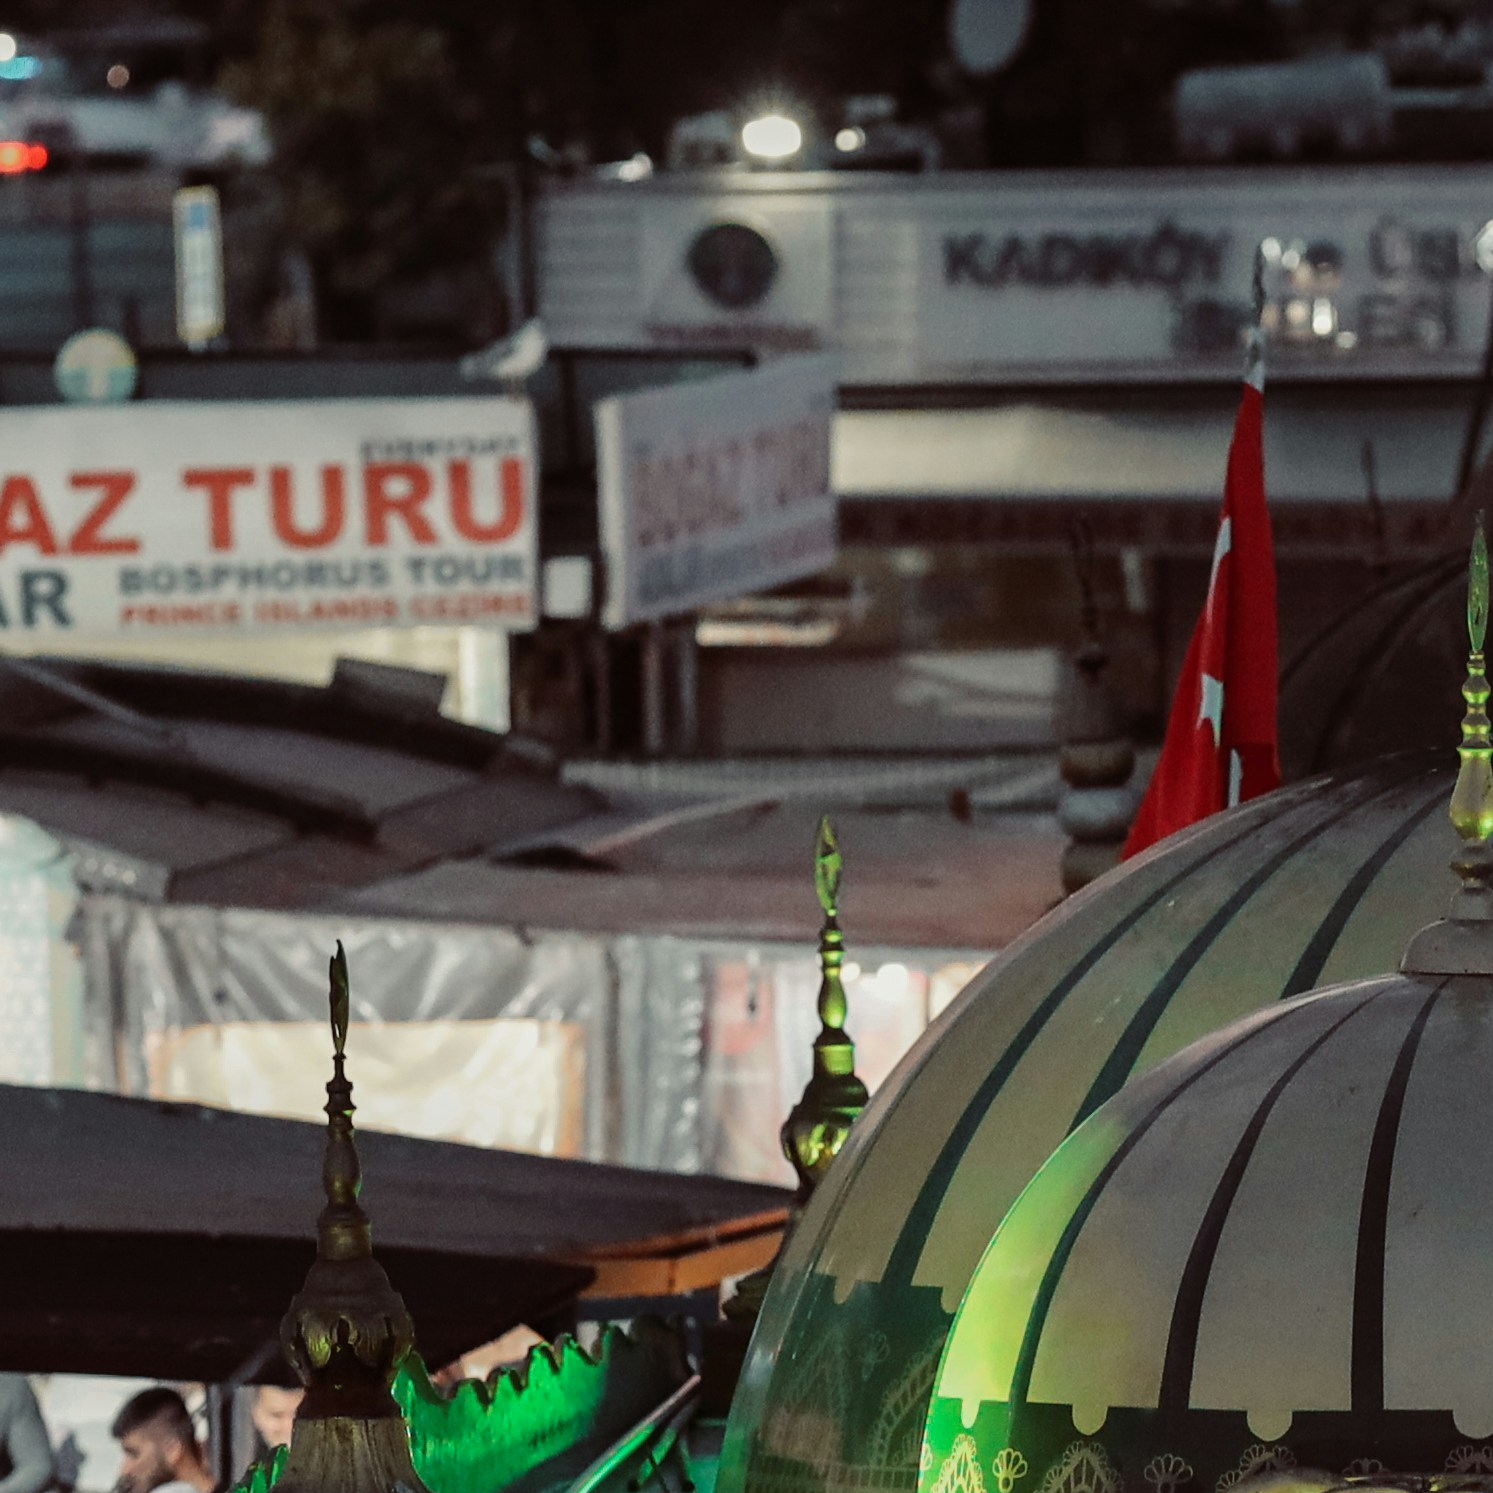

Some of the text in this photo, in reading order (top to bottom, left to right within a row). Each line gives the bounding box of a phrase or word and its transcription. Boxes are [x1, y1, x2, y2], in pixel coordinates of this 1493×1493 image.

[0, 457, 525, 556] AZ TURU
[118, 555, 525, 598] BOSPHORUS TOUR
[253, 598, 397, 624] ISLANDS
